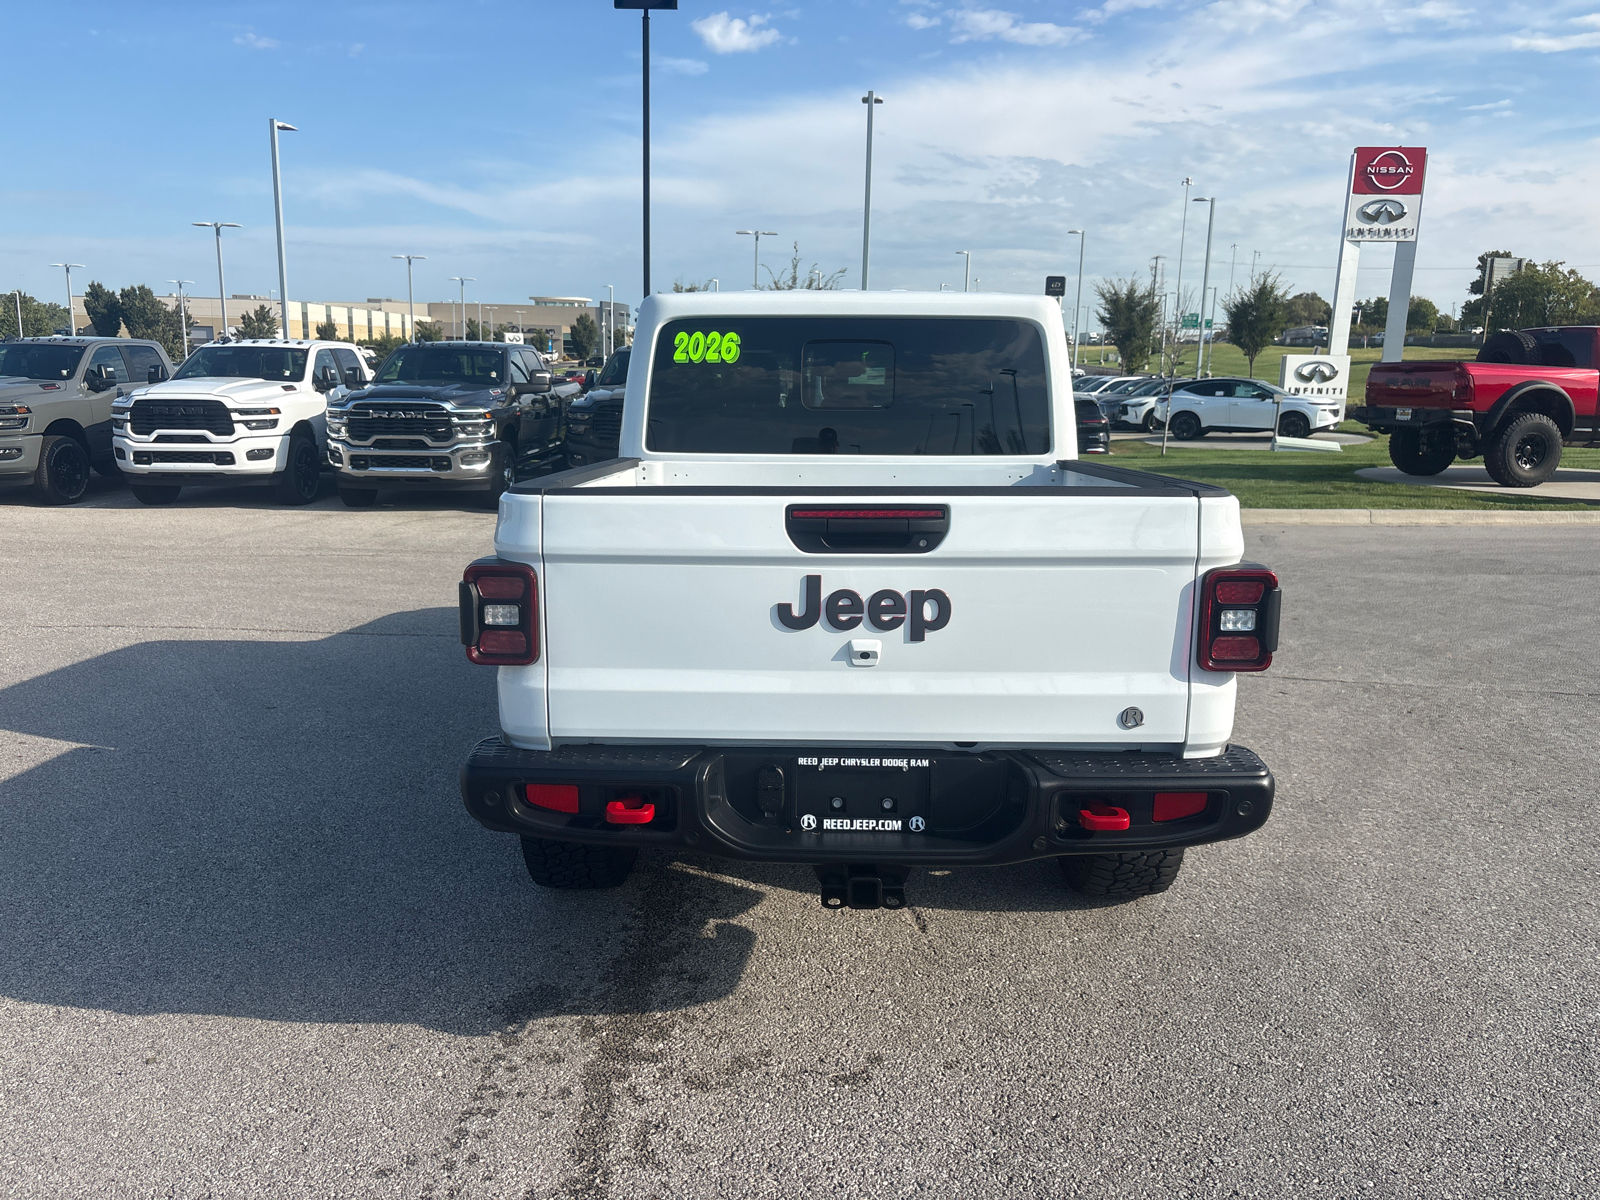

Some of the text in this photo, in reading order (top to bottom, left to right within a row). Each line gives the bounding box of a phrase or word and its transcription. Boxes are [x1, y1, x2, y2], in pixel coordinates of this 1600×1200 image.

[1367, 166, 1414, 174] NISSAN
[1350, 227, 1415, 236] INFINITI
[673, 331, 741, 364] 2026
[1386, 377, 1431, 387] RAM
[1288, 386, 1343, 395] INFINITI
[153, 406, 205, 415] RAM
[372, 410, 423, 419] RAM
[777, 574, 952, 642] Jeep
[798, 757, 929, 767] REED JEEP CHRYSLER DODGE RAM
[823, 818, 902, 831] REEDJEEP.COM
